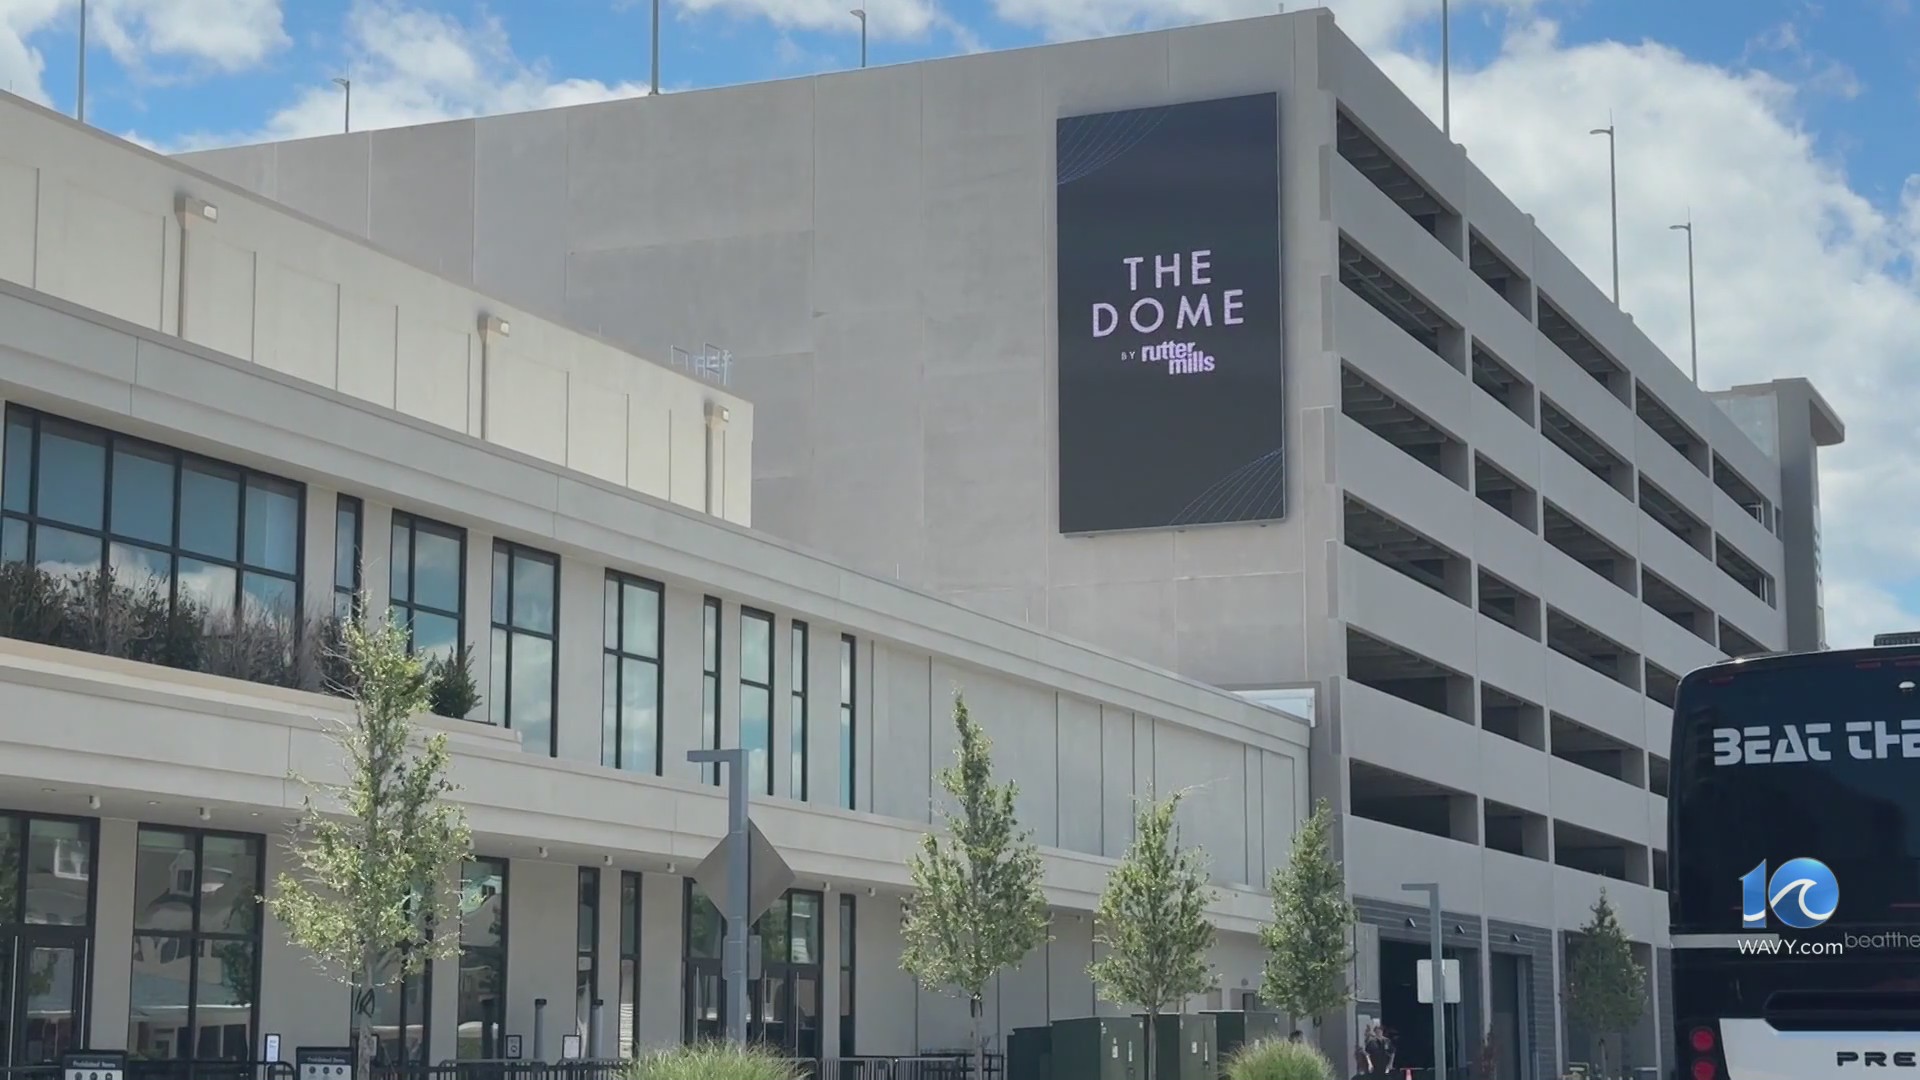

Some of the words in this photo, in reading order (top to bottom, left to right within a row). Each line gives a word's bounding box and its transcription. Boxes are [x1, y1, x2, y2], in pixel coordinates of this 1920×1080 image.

[1123, 250, 1211, 290] THE
[1092, 289, 1244, 337] DOME
[1121, 351, 1135, 360] BY
[1141, 340, 1196, 362] rutter
[1168, 350, 1215, 375] mills
[1713, 723, 1832, 766] BEAT
[1846, 719, 1920, 759] THE
[1844, 932, 1920, 948] beatthe
[1836, 1051, 1917, 1067] PRE
